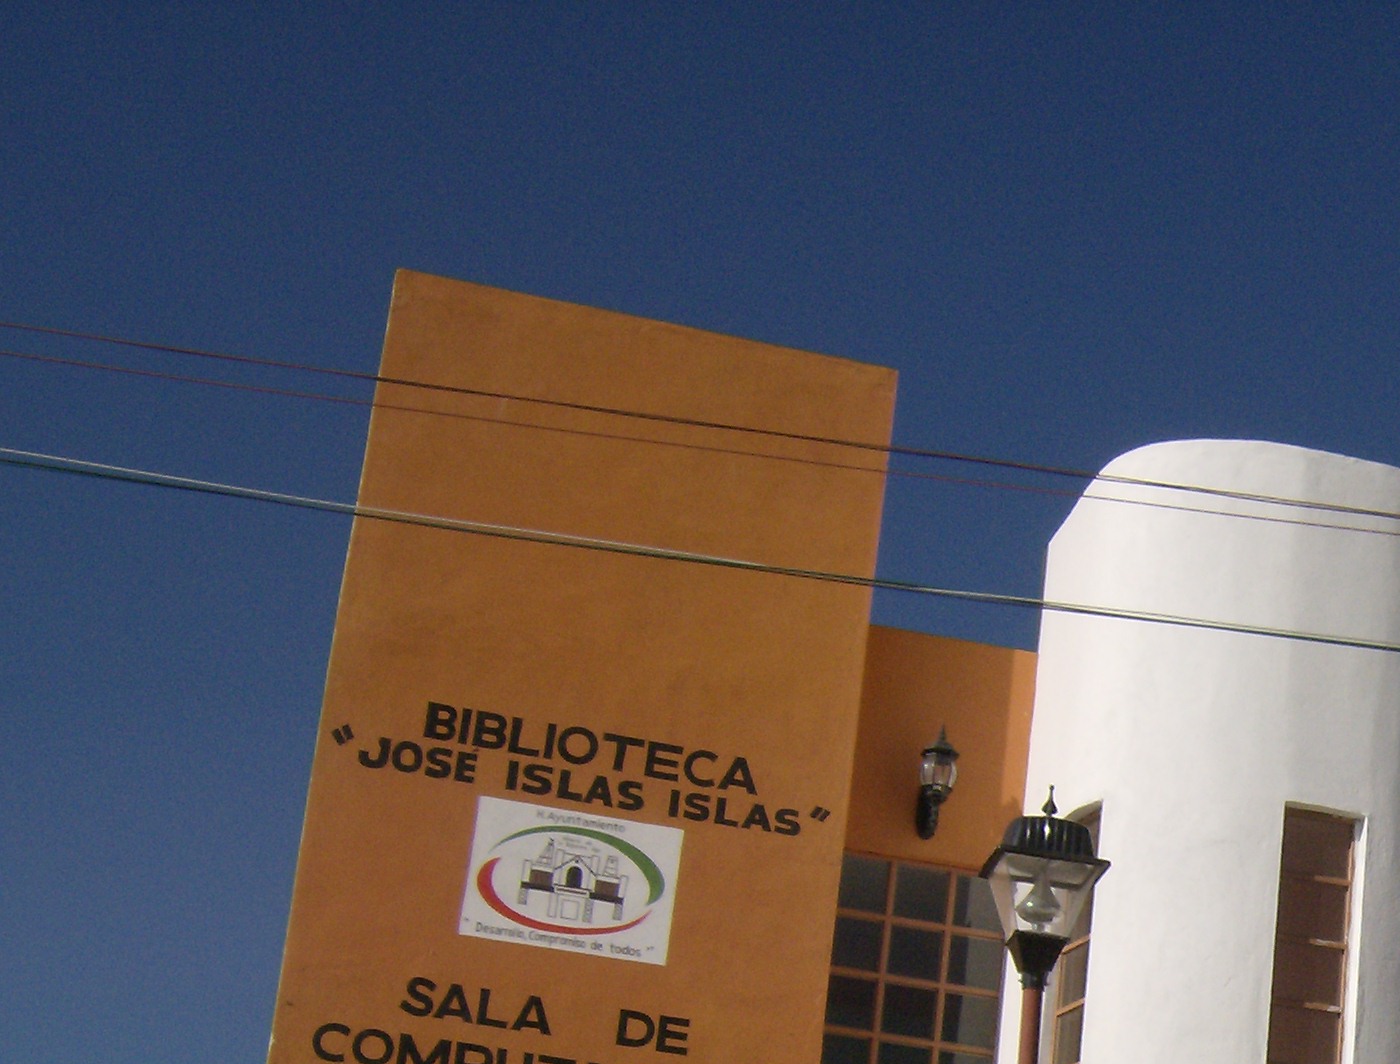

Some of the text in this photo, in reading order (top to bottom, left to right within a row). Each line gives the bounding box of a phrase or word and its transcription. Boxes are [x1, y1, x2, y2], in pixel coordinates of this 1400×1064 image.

[424, 701, 758, 796] BIBLIOTECA
[505, 760, 645, 811] ISLAS
[400, 976, 691, 1055] SALA DE
